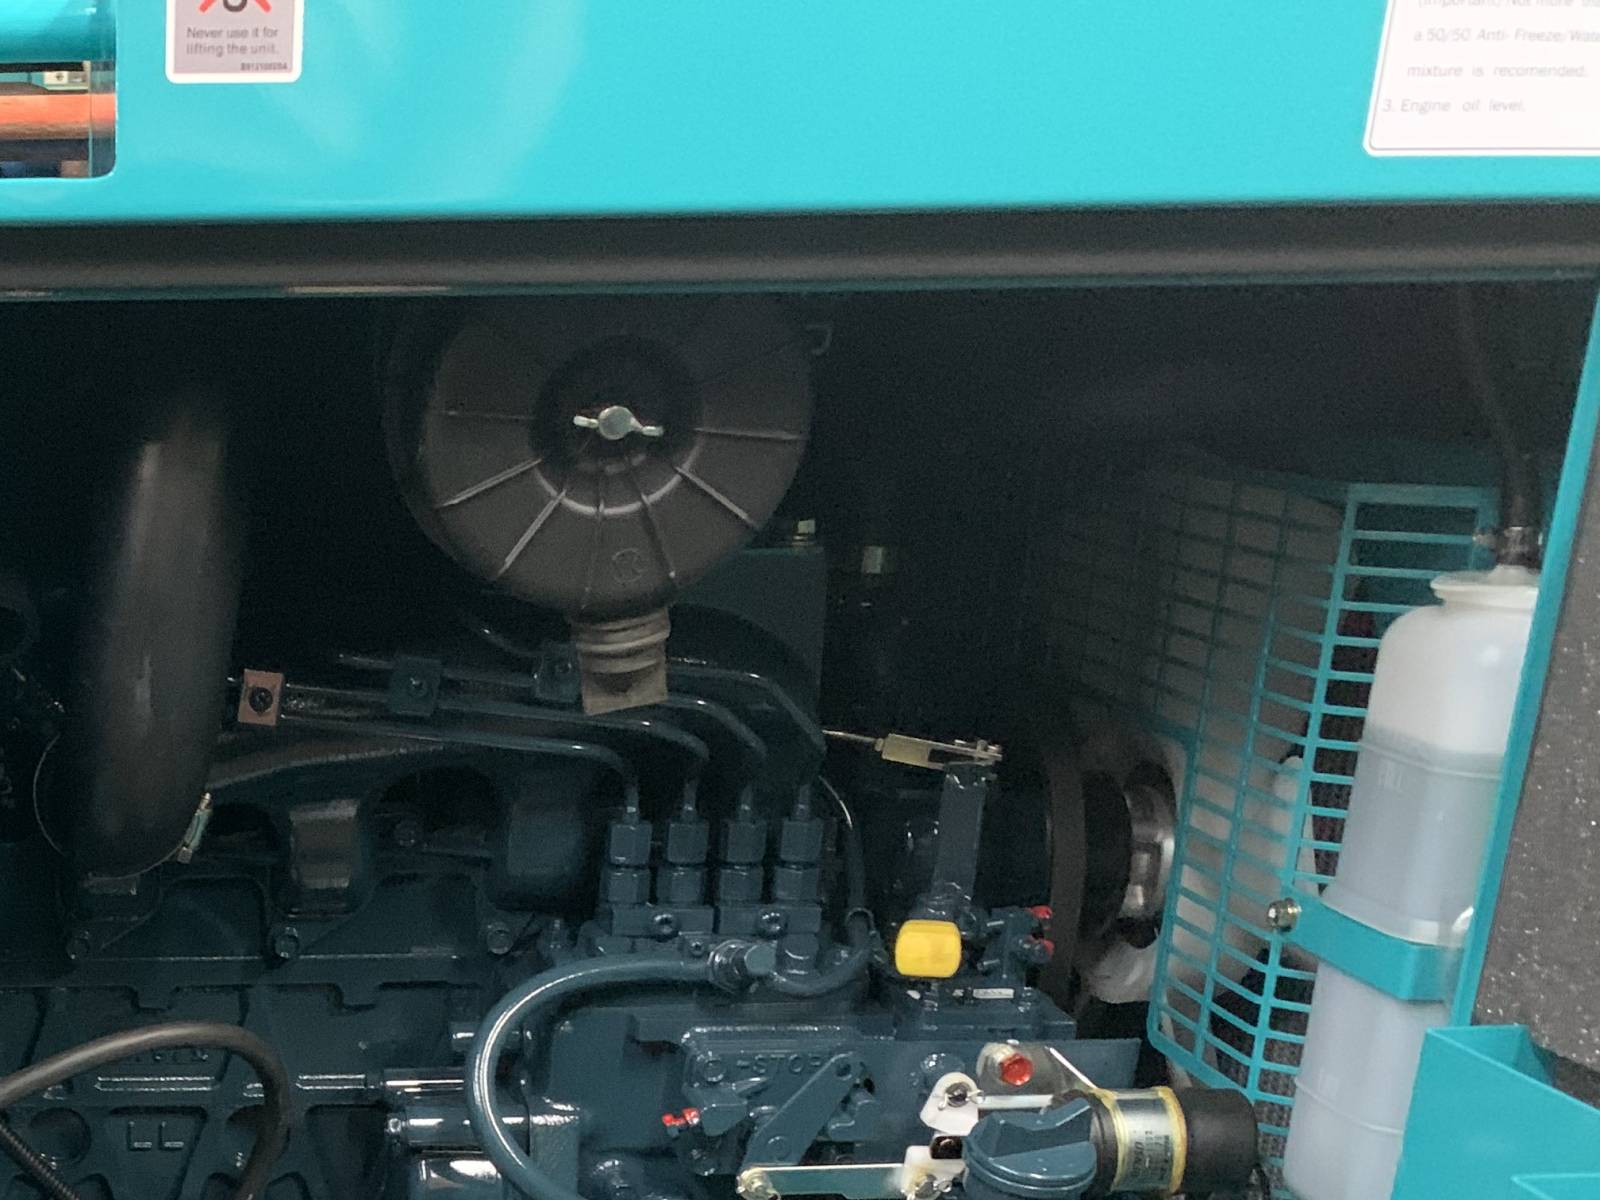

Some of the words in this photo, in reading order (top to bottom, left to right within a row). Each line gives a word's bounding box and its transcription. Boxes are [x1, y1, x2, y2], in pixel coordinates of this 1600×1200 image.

[186, 27, 223, 38] Never
[227, 29, 249, 38] use
[252, 28, 259, 38] it
[263, 27, 279, 38] for
[1426, 27, 1472, 42] 50/50
[186, 43, 224, 58] lifting
[227, 43, 248, 54] the
[251, 44, 279, 54] unit.
[1407, 66, 1464, 77] mixture
[1471, 65, 1484, 77] is
[1399, 98, 1452, 114] Engine
[1462, 98, 1481, 112] oil
[1488, 98, 1526, 112] level.
